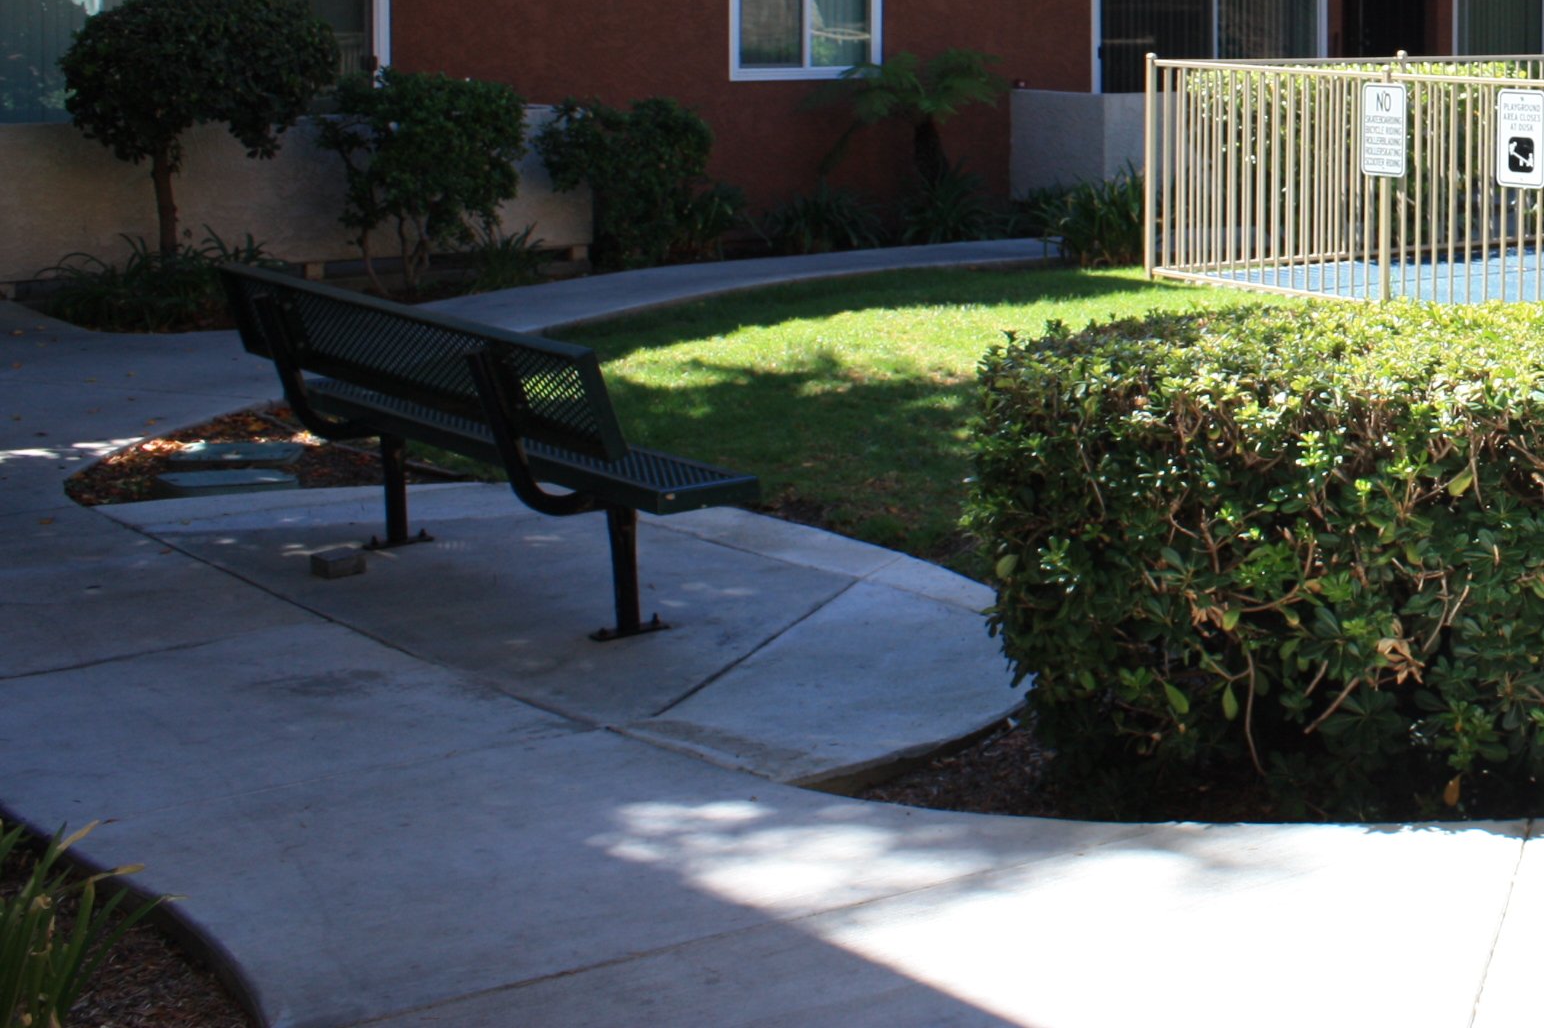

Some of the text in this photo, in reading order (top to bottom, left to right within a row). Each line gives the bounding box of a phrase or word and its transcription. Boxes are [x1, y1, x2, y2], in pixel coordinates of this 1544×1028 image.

[1376, 92, 1391, 112] NO
[1503, 102, 1541, 112] PLAYGROUND
[1503, 113, 1541, 123] AREA CLOSES
